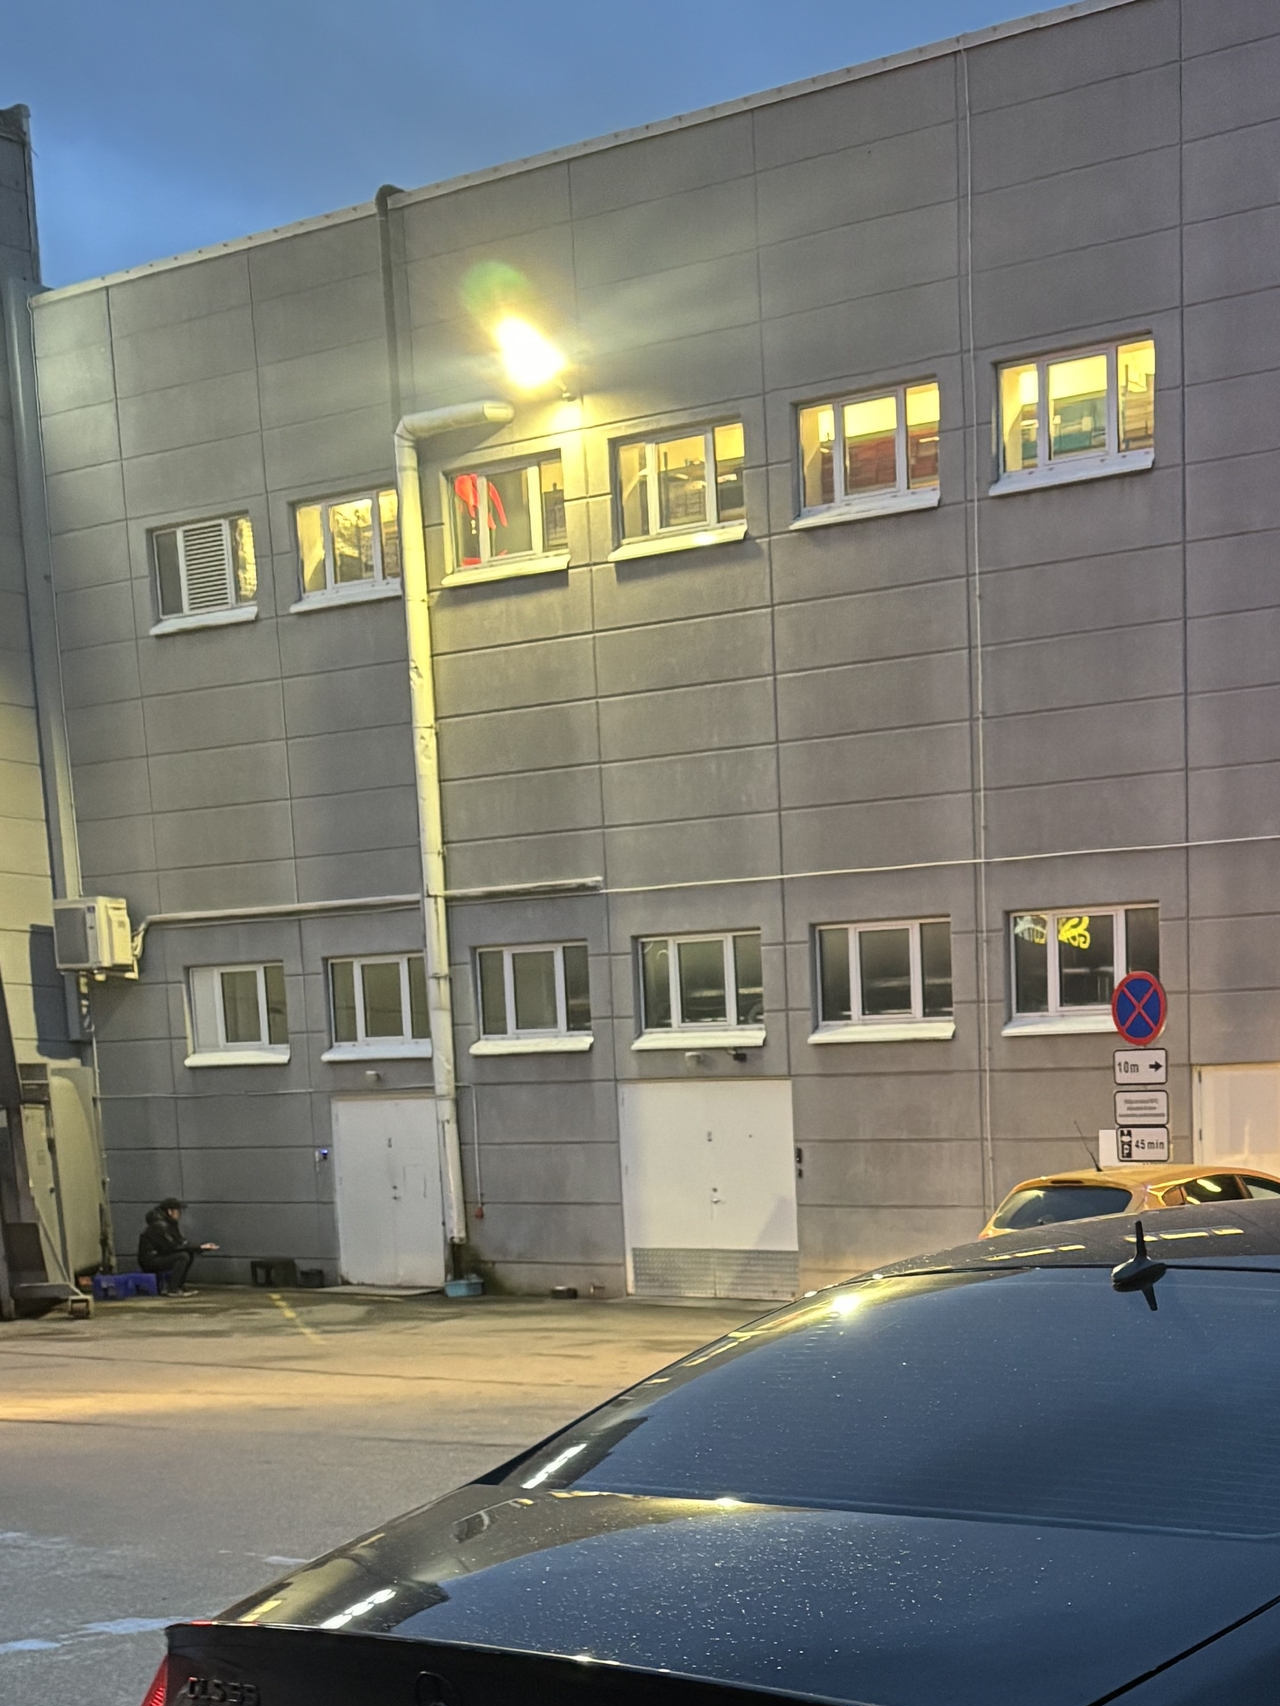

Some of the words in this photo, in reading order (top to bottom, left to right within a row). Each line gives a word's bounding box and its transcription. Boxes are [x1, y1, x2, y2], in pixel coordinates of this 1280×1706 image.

[1117, 1061, 1139, 1073] 10m
[1134, 1139, 1146, 1150] 45
[1147, 1139, 1165, 1150] min
